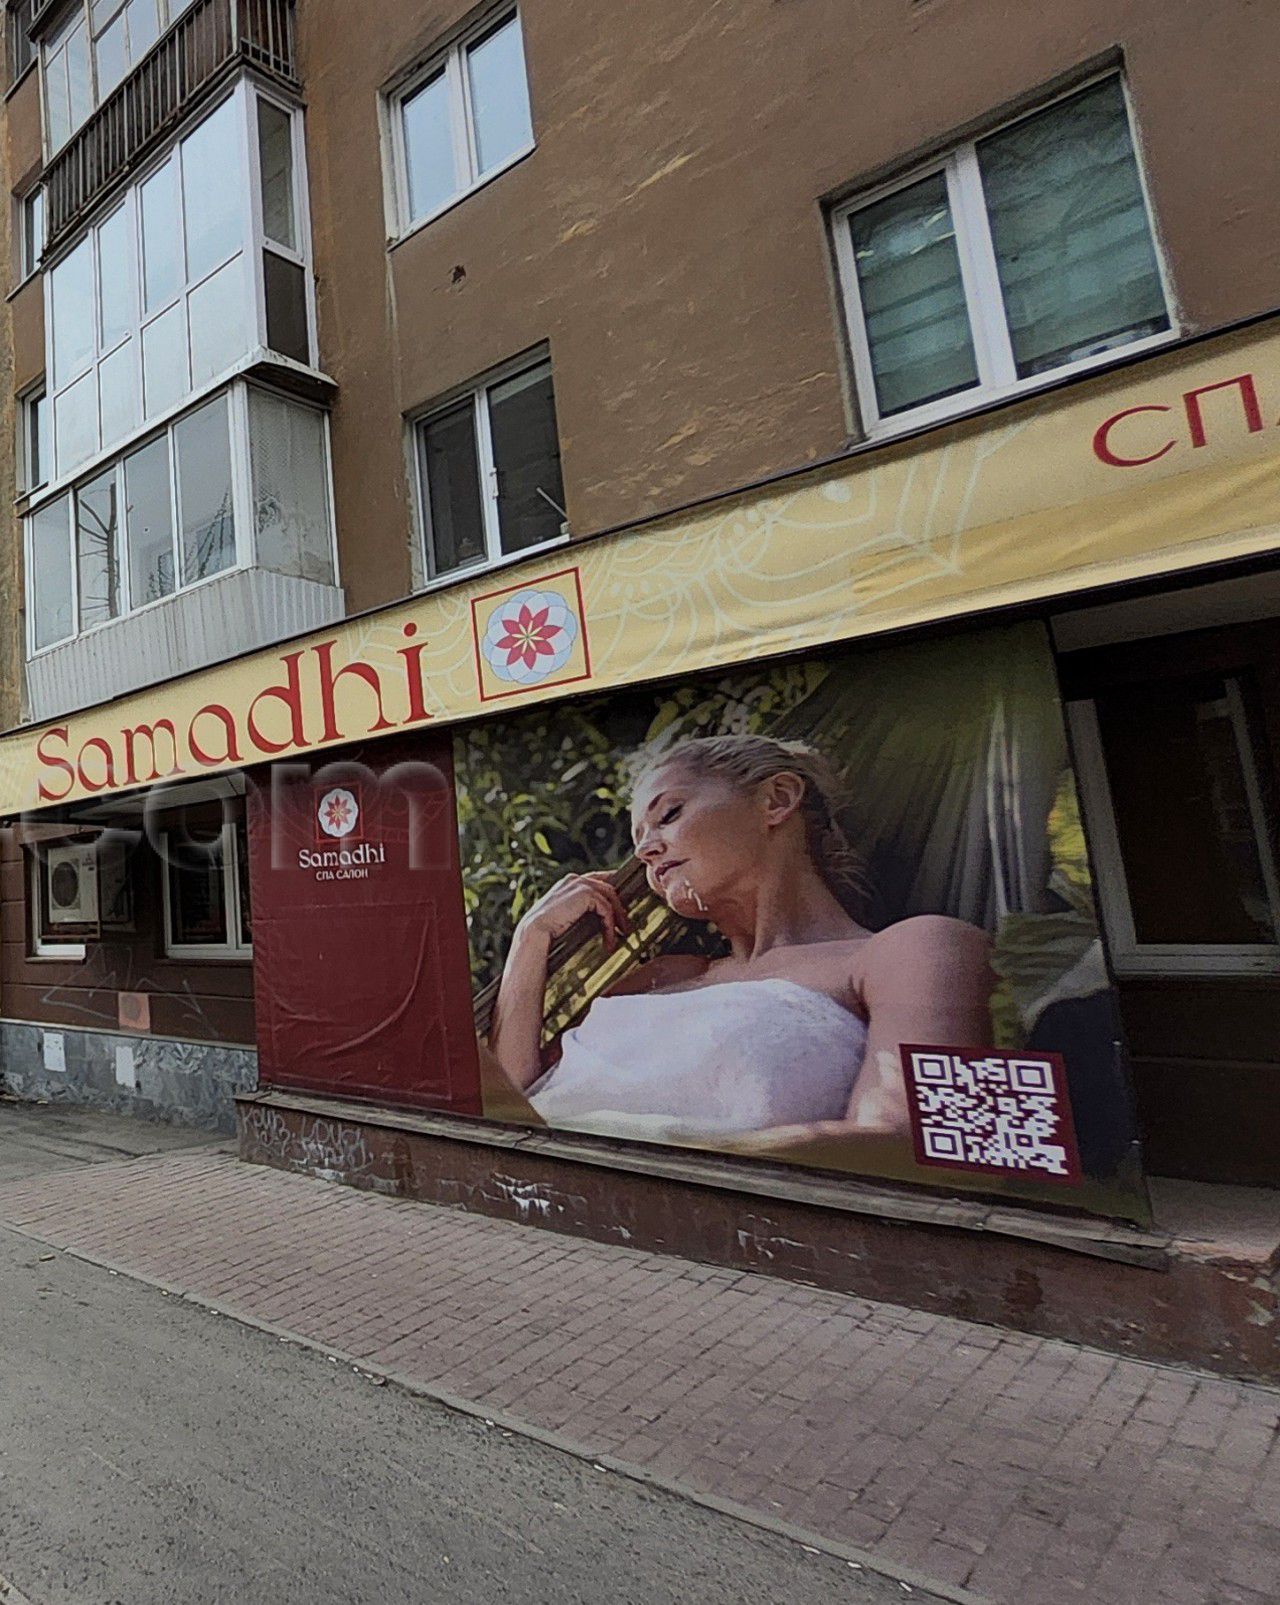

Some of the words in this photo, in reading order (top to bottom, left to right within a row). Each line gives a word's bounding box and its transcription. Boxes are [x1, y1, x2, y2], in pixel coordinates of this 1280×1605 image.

[1093, 373, 1280, 468] СП
[37, 622, 434, 801] Samadhi
[299, 843, 385, 868] Samadhi
[317, 870, 335, 881] СПА
[336, 868, 368, 880] САЛОН
